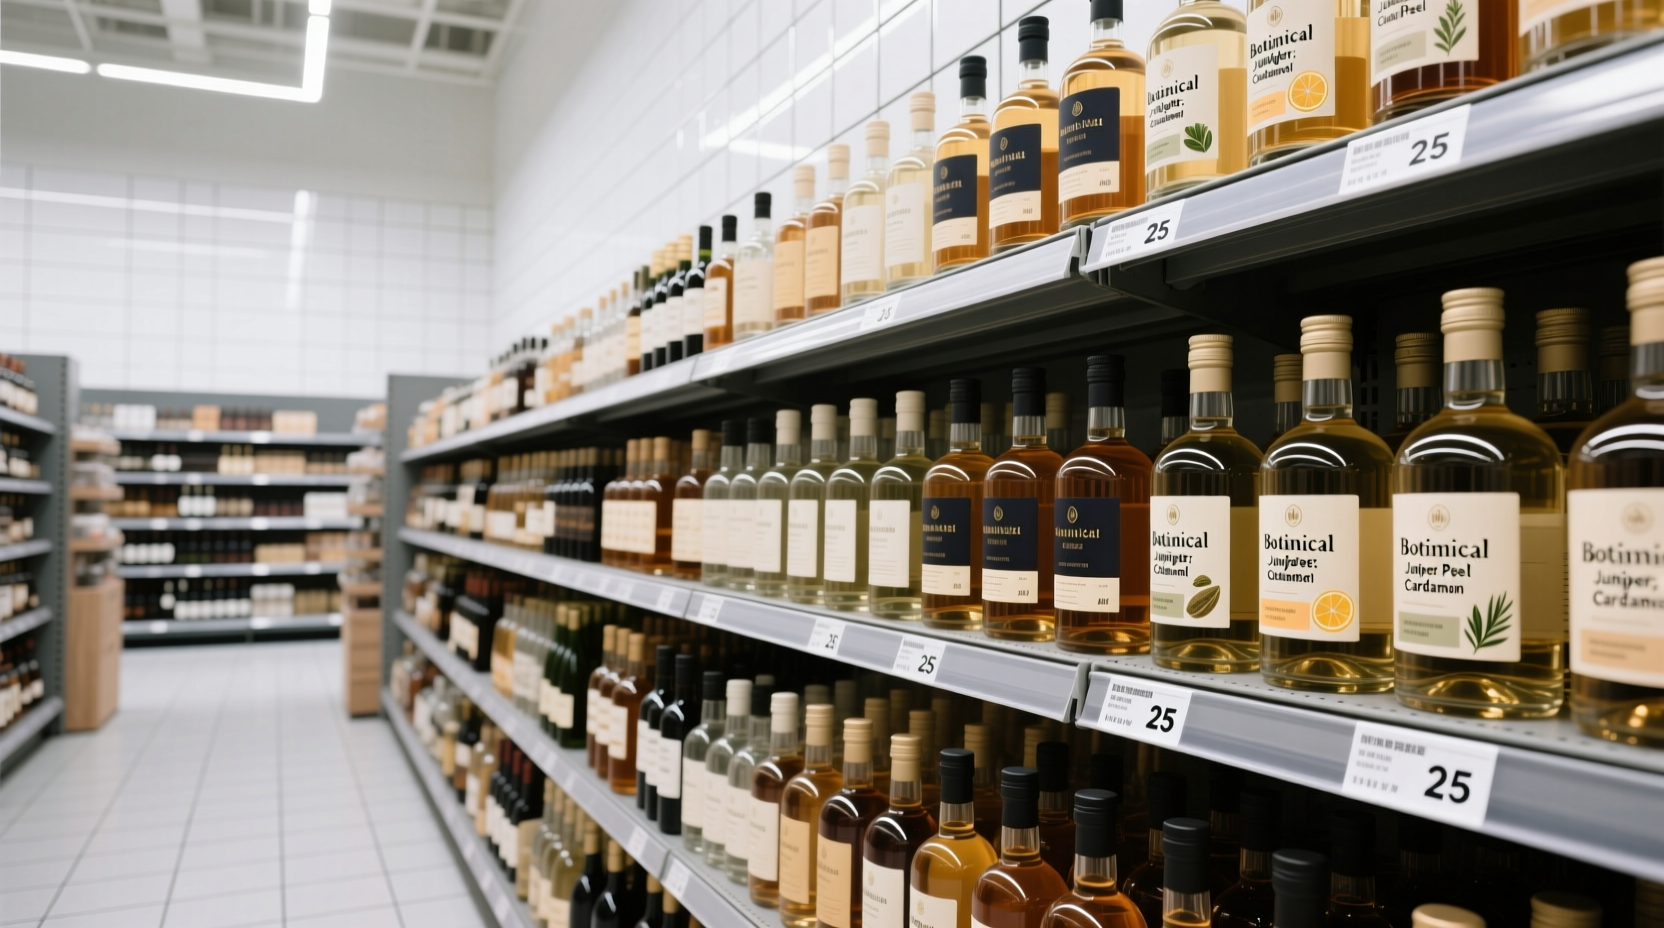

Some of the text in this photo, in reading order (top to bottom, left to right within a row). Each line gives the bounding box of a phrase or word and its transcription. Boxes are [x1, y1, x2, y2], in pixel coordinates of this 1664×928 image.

[1408, 131, 1450, 167] 25
[1143, 218, 1171, 245] 25
[1442, 563, 1471, 578] Peel
[917, 654, 937, 675] 25
[1145, 704, 1178, 733] 25
[1424, 765, 1472, 804] 25
